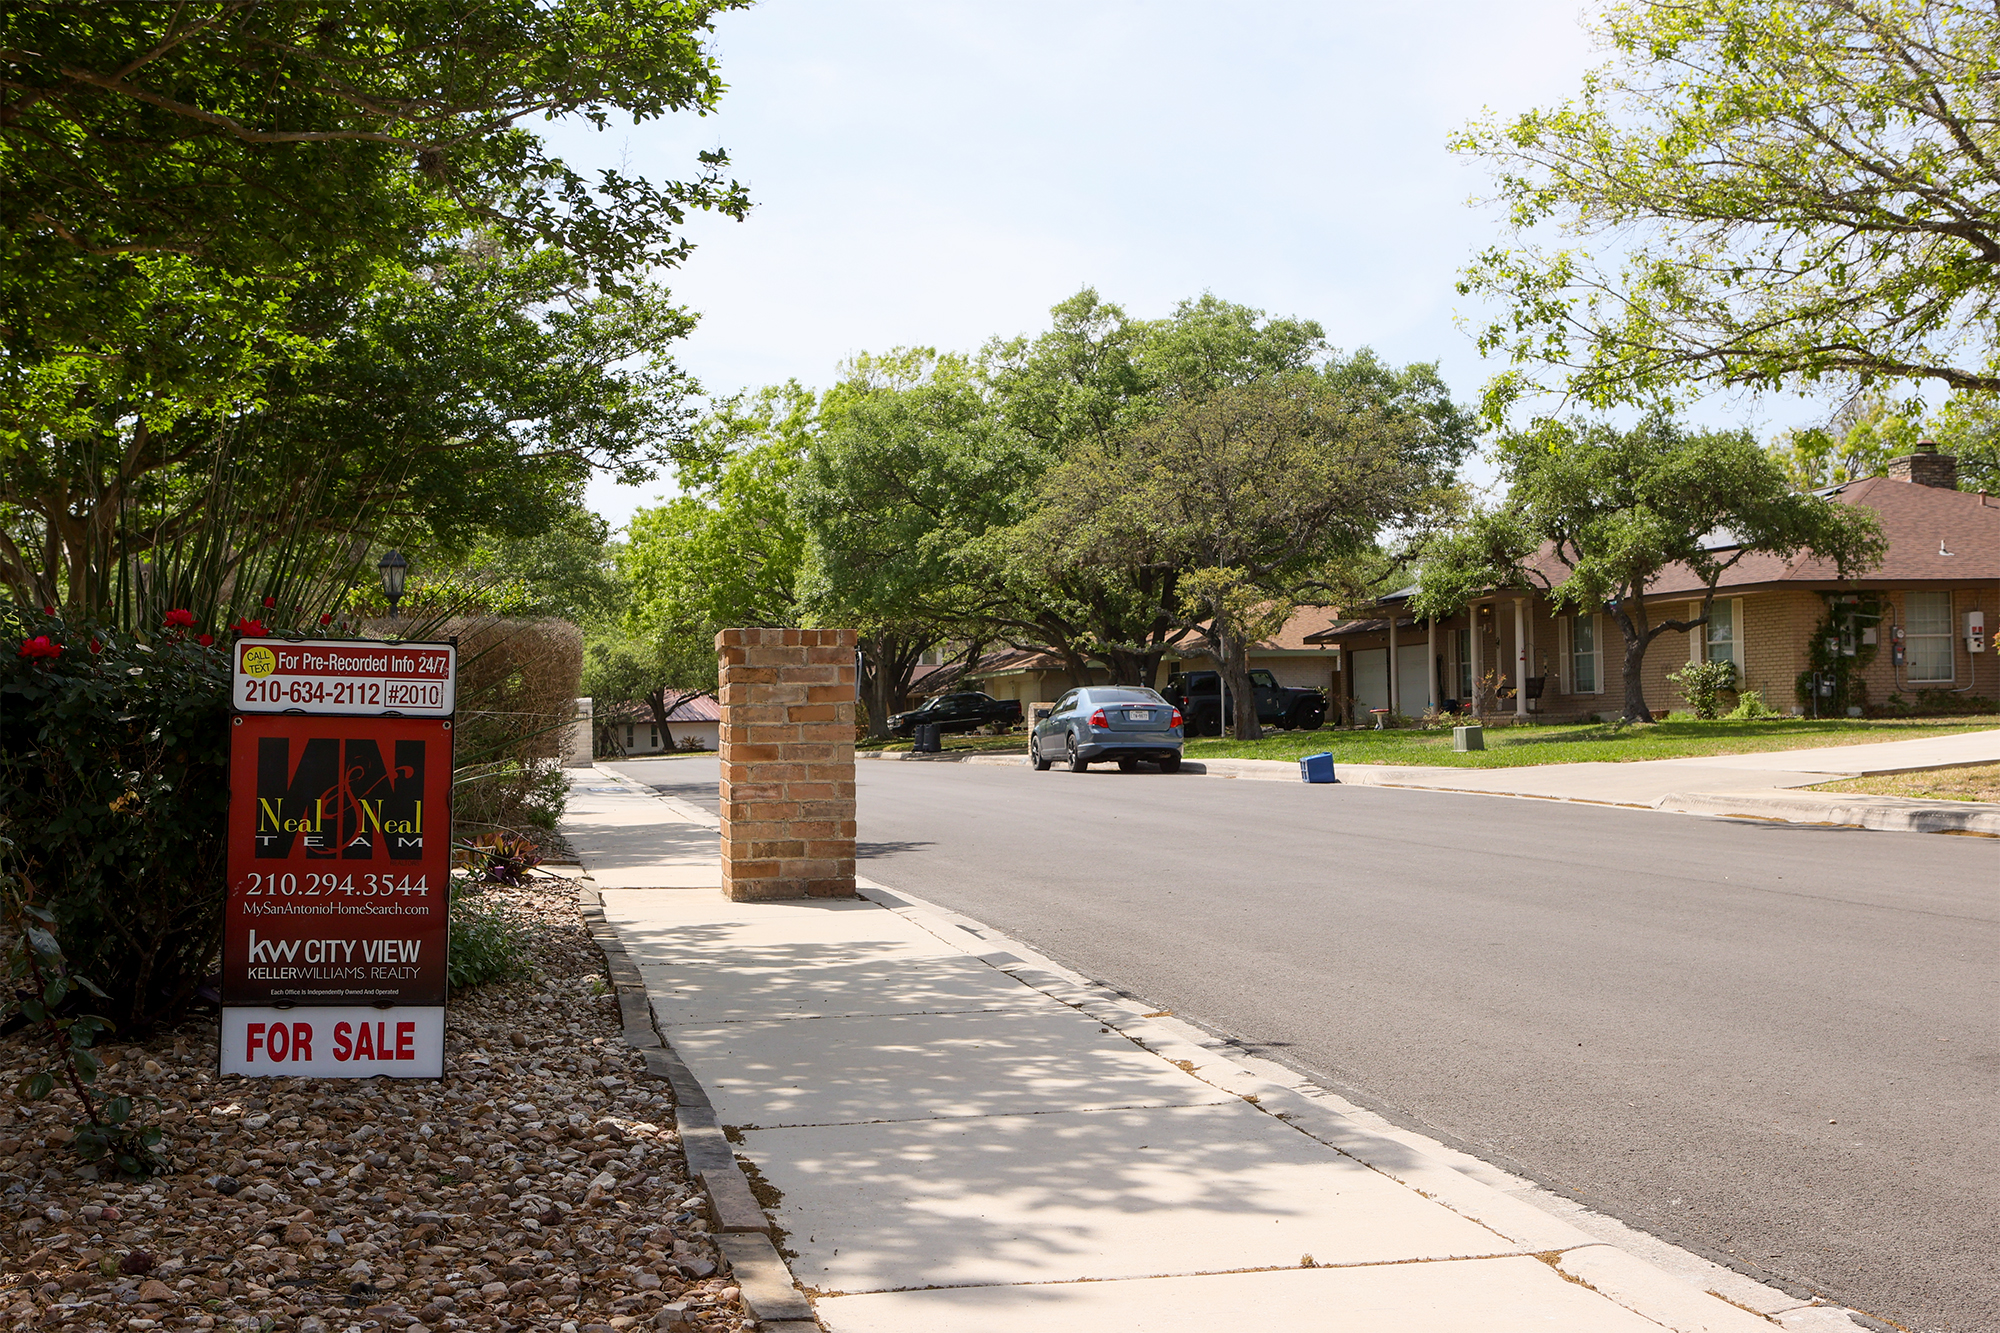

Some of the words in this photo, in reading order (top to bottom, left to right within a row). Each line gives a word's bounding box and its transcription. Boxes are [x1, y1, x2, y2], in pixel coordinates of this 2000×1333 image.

[247, 650, 270, 662] CALL
[278, 652, 299, 669] For
[302, 653, 387, 672] Pre-Recorded
[391, 656, 415, 673] Info
[418, 656, 447, 674] 24/7
[248, 663, 270, 674] TEXT
[245, 680, 380, 705] 210-634-2112
[388, 685, 438, 705] #2010
[257, 798, 323, 833] Neal
[358, 799, 423, 835] Neal
[255, 835, 423, 848] TEAM
[245, 872, 429, 897] 210.294.3544
[243, 901, 429, 917] MySanAntonioHomeSearch.com
[248, 929, 302, 963] kw
[304, 939, 357, 963] CITY
[362, 939, 422, 963] VIEW
[371, 967, 421, 980] REALTY
[307, 989, 344, 997] Independently
[246, 1022, 313, 1063] FOR
[332, 1021, 416, 1062] SALE
